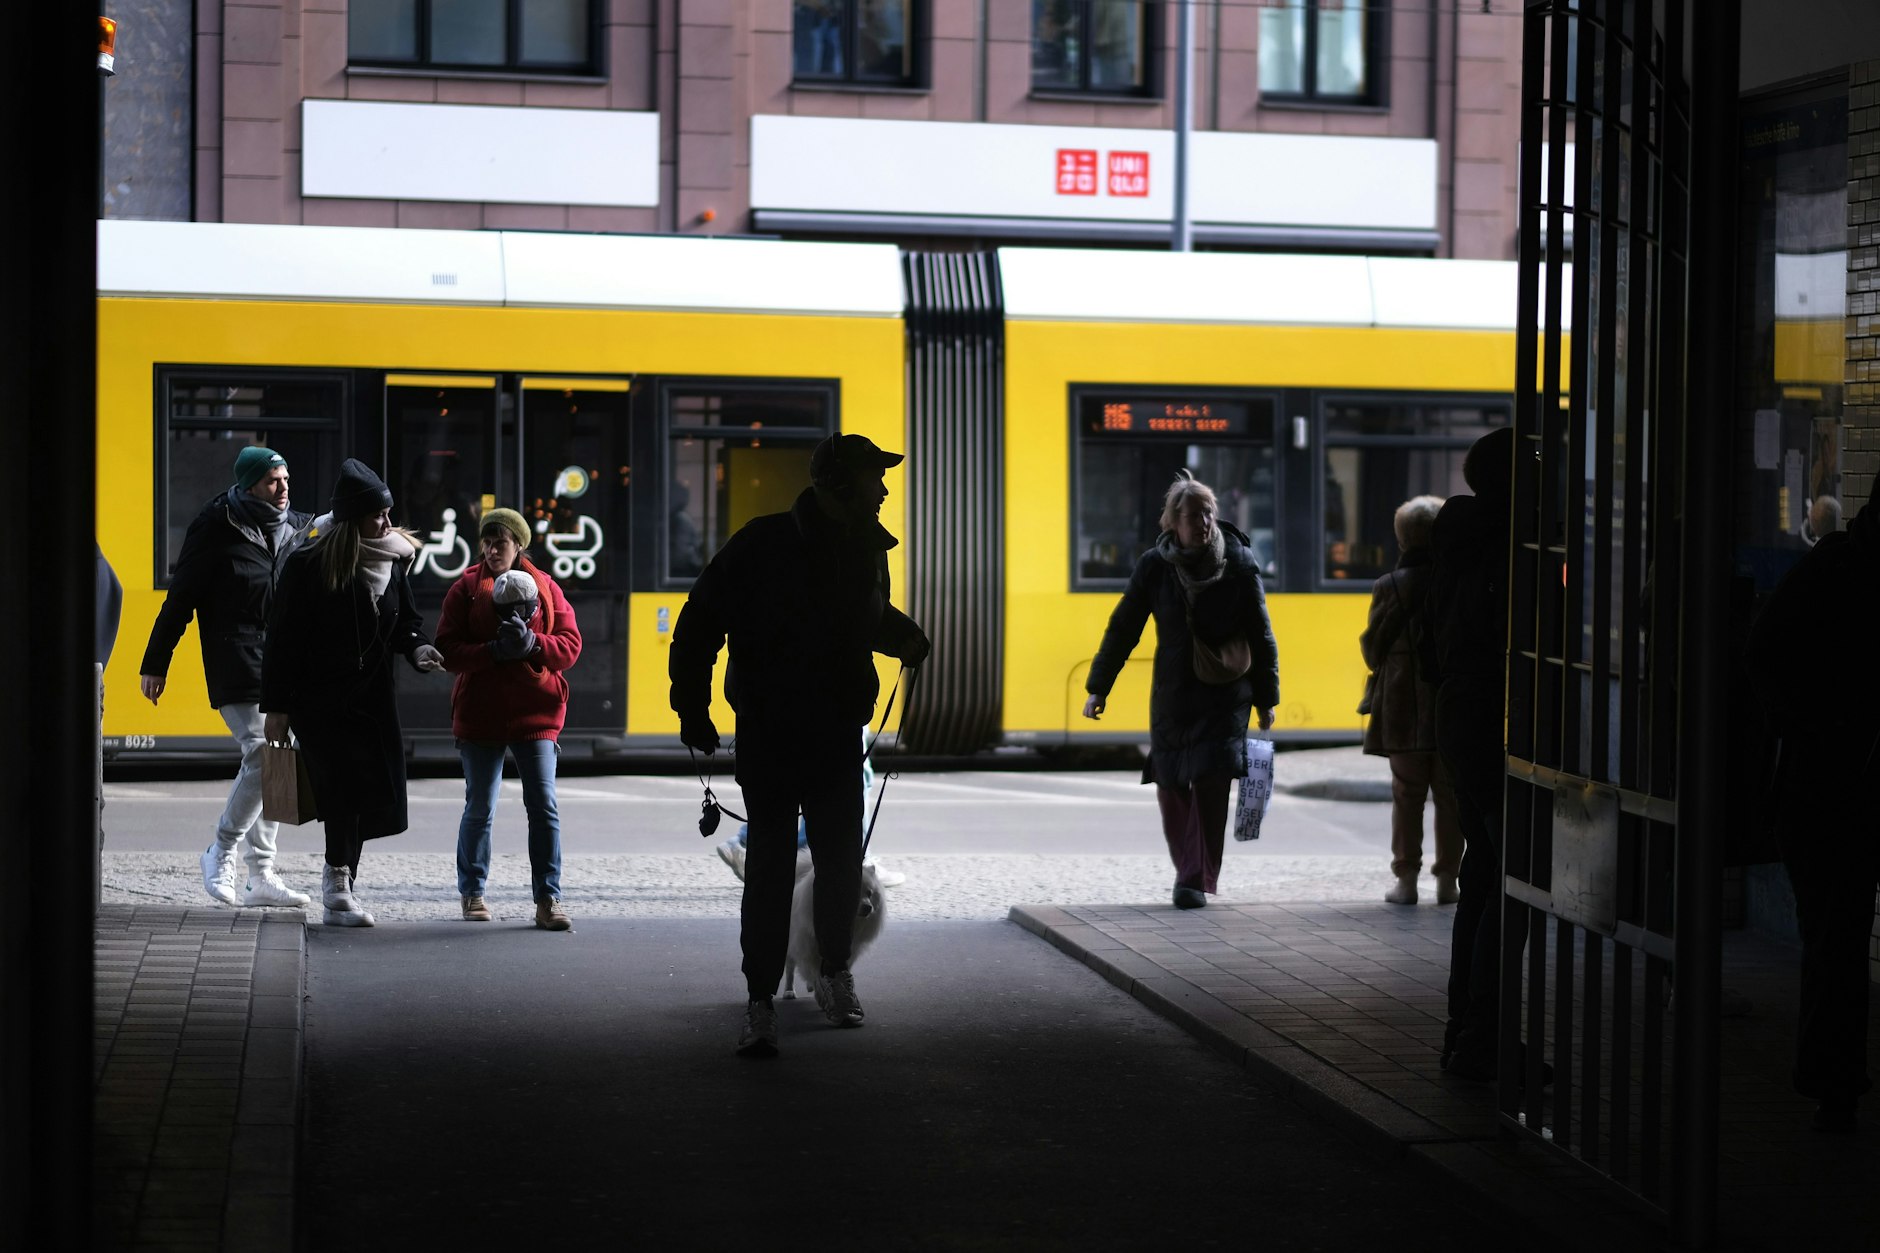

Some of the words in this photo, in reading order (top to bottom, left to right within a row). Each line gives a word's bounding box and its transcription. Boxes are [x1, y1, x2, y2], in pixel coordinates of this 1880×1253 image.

[1111, 156, 1144, 173] UNI
[1111, 175, 1144, 193] QLO
[125, 734, 156, 748] 8025
[1240, 788, 1262, 799] SEL
